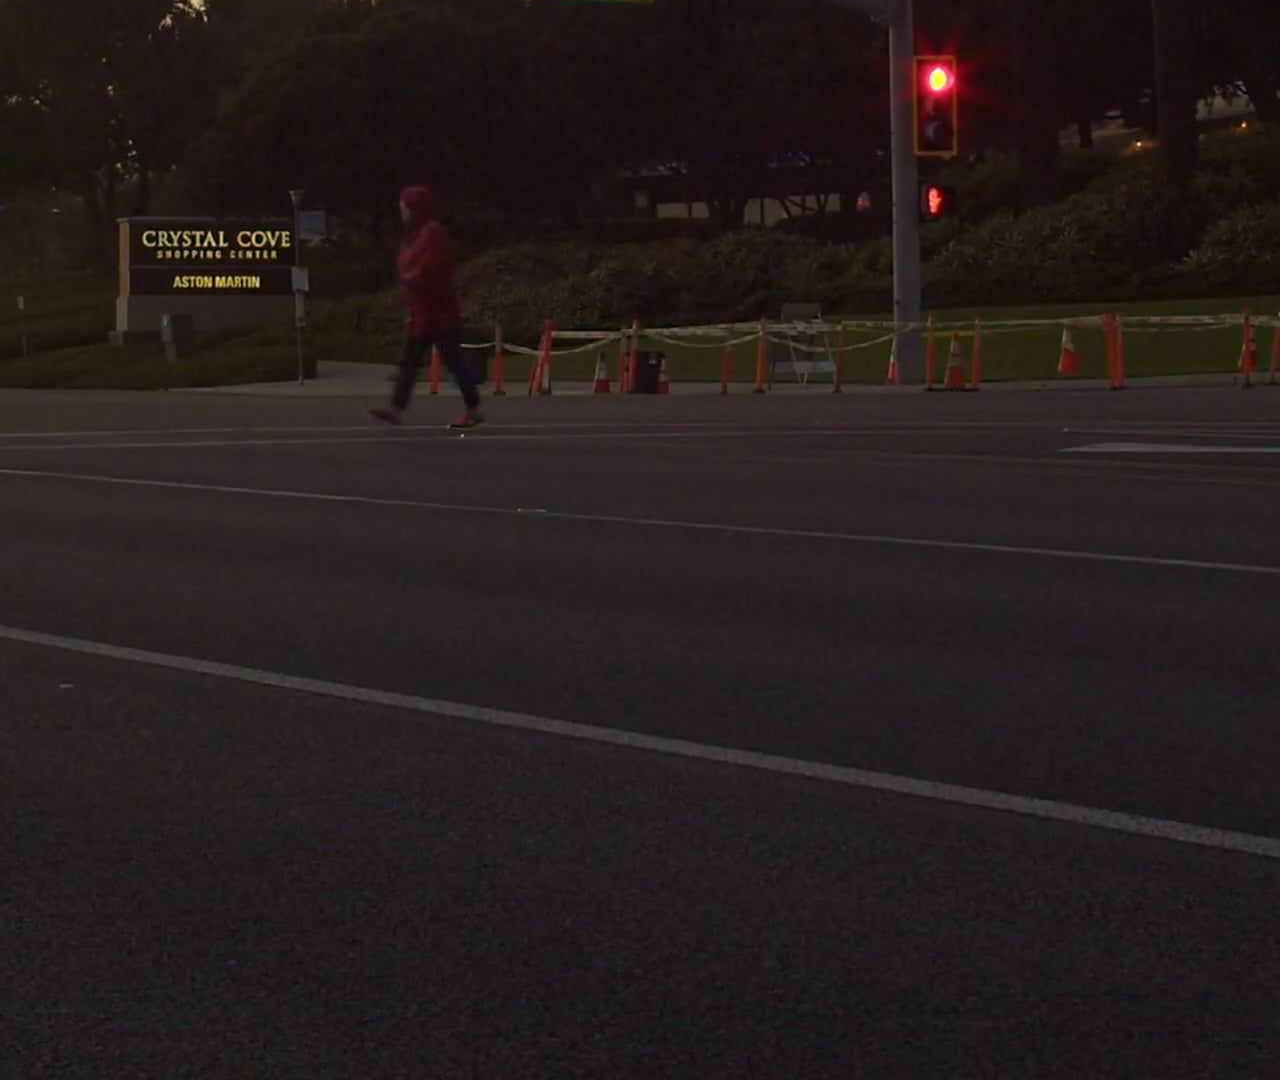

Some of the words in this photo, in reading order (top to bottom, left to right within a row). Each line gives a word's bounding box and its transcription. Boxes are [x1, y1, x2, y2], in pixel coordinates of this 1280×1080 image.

[142, 230, 229, 248] CRYSTAL
[237, 230, 291, 248] COVE
[156, 249, 222, 259] SHOPPING
[230, 249, 278, 259] CENTER
[173, 275, 213, 289] ASTON
[215, 275, 261, 289] MARTIN
